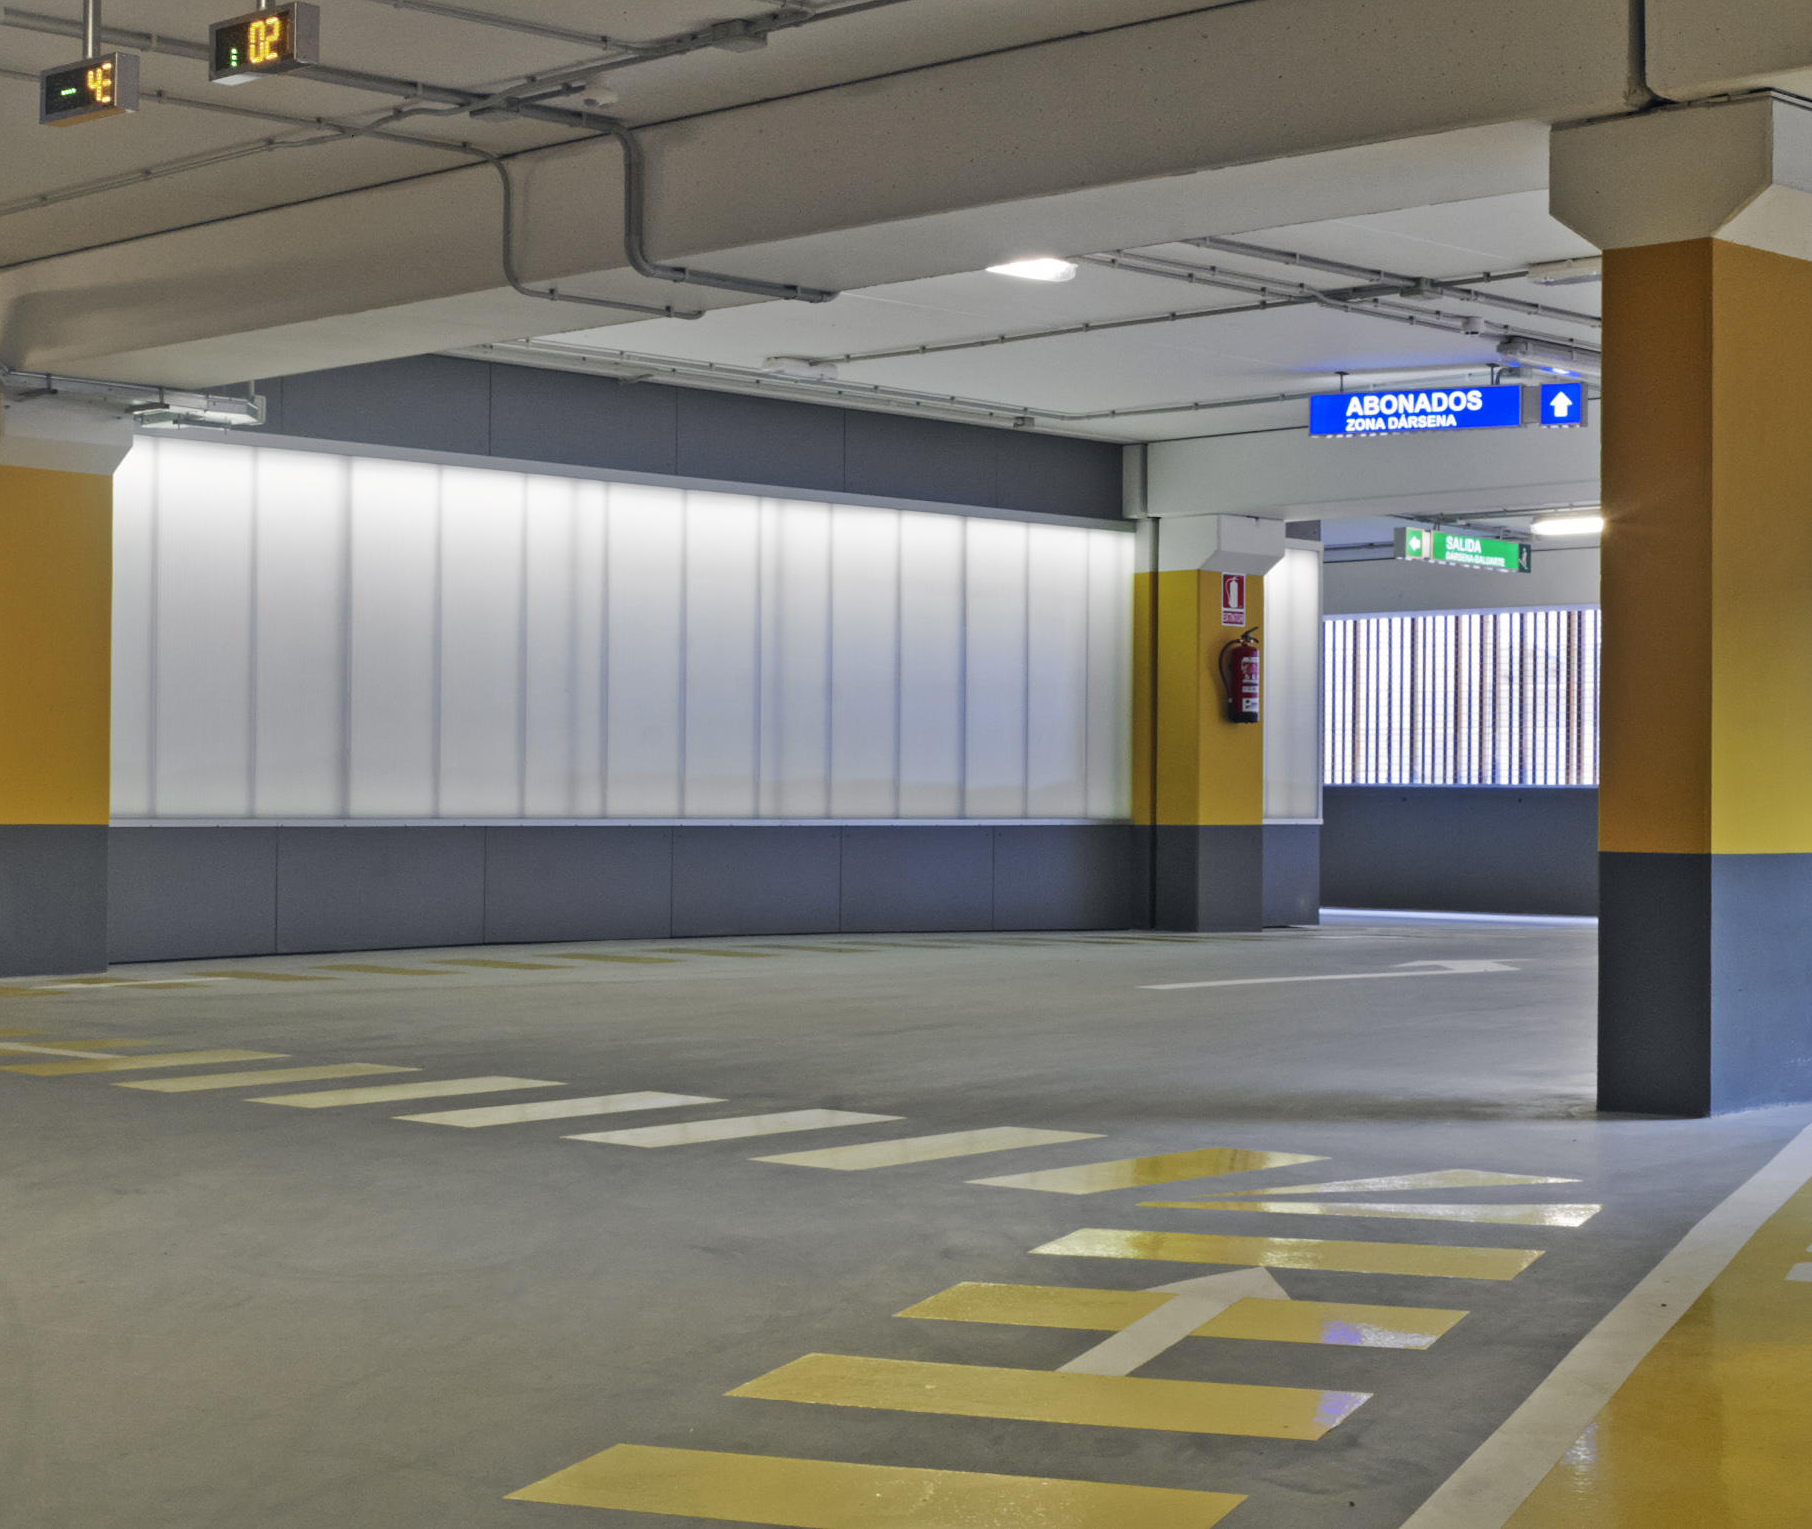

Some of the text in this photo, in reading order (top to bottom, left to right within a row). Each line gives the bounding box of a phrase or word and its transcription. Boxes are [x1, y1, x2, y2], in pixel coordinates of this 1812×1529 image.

[250, 17, 279, 63] 02
[1345, 390, 1483, 416] ABONADOS
[1345, 413, 1457, 432] ZONA DÁRSENA
[1445, 535, 1482, 554] SALIDA
